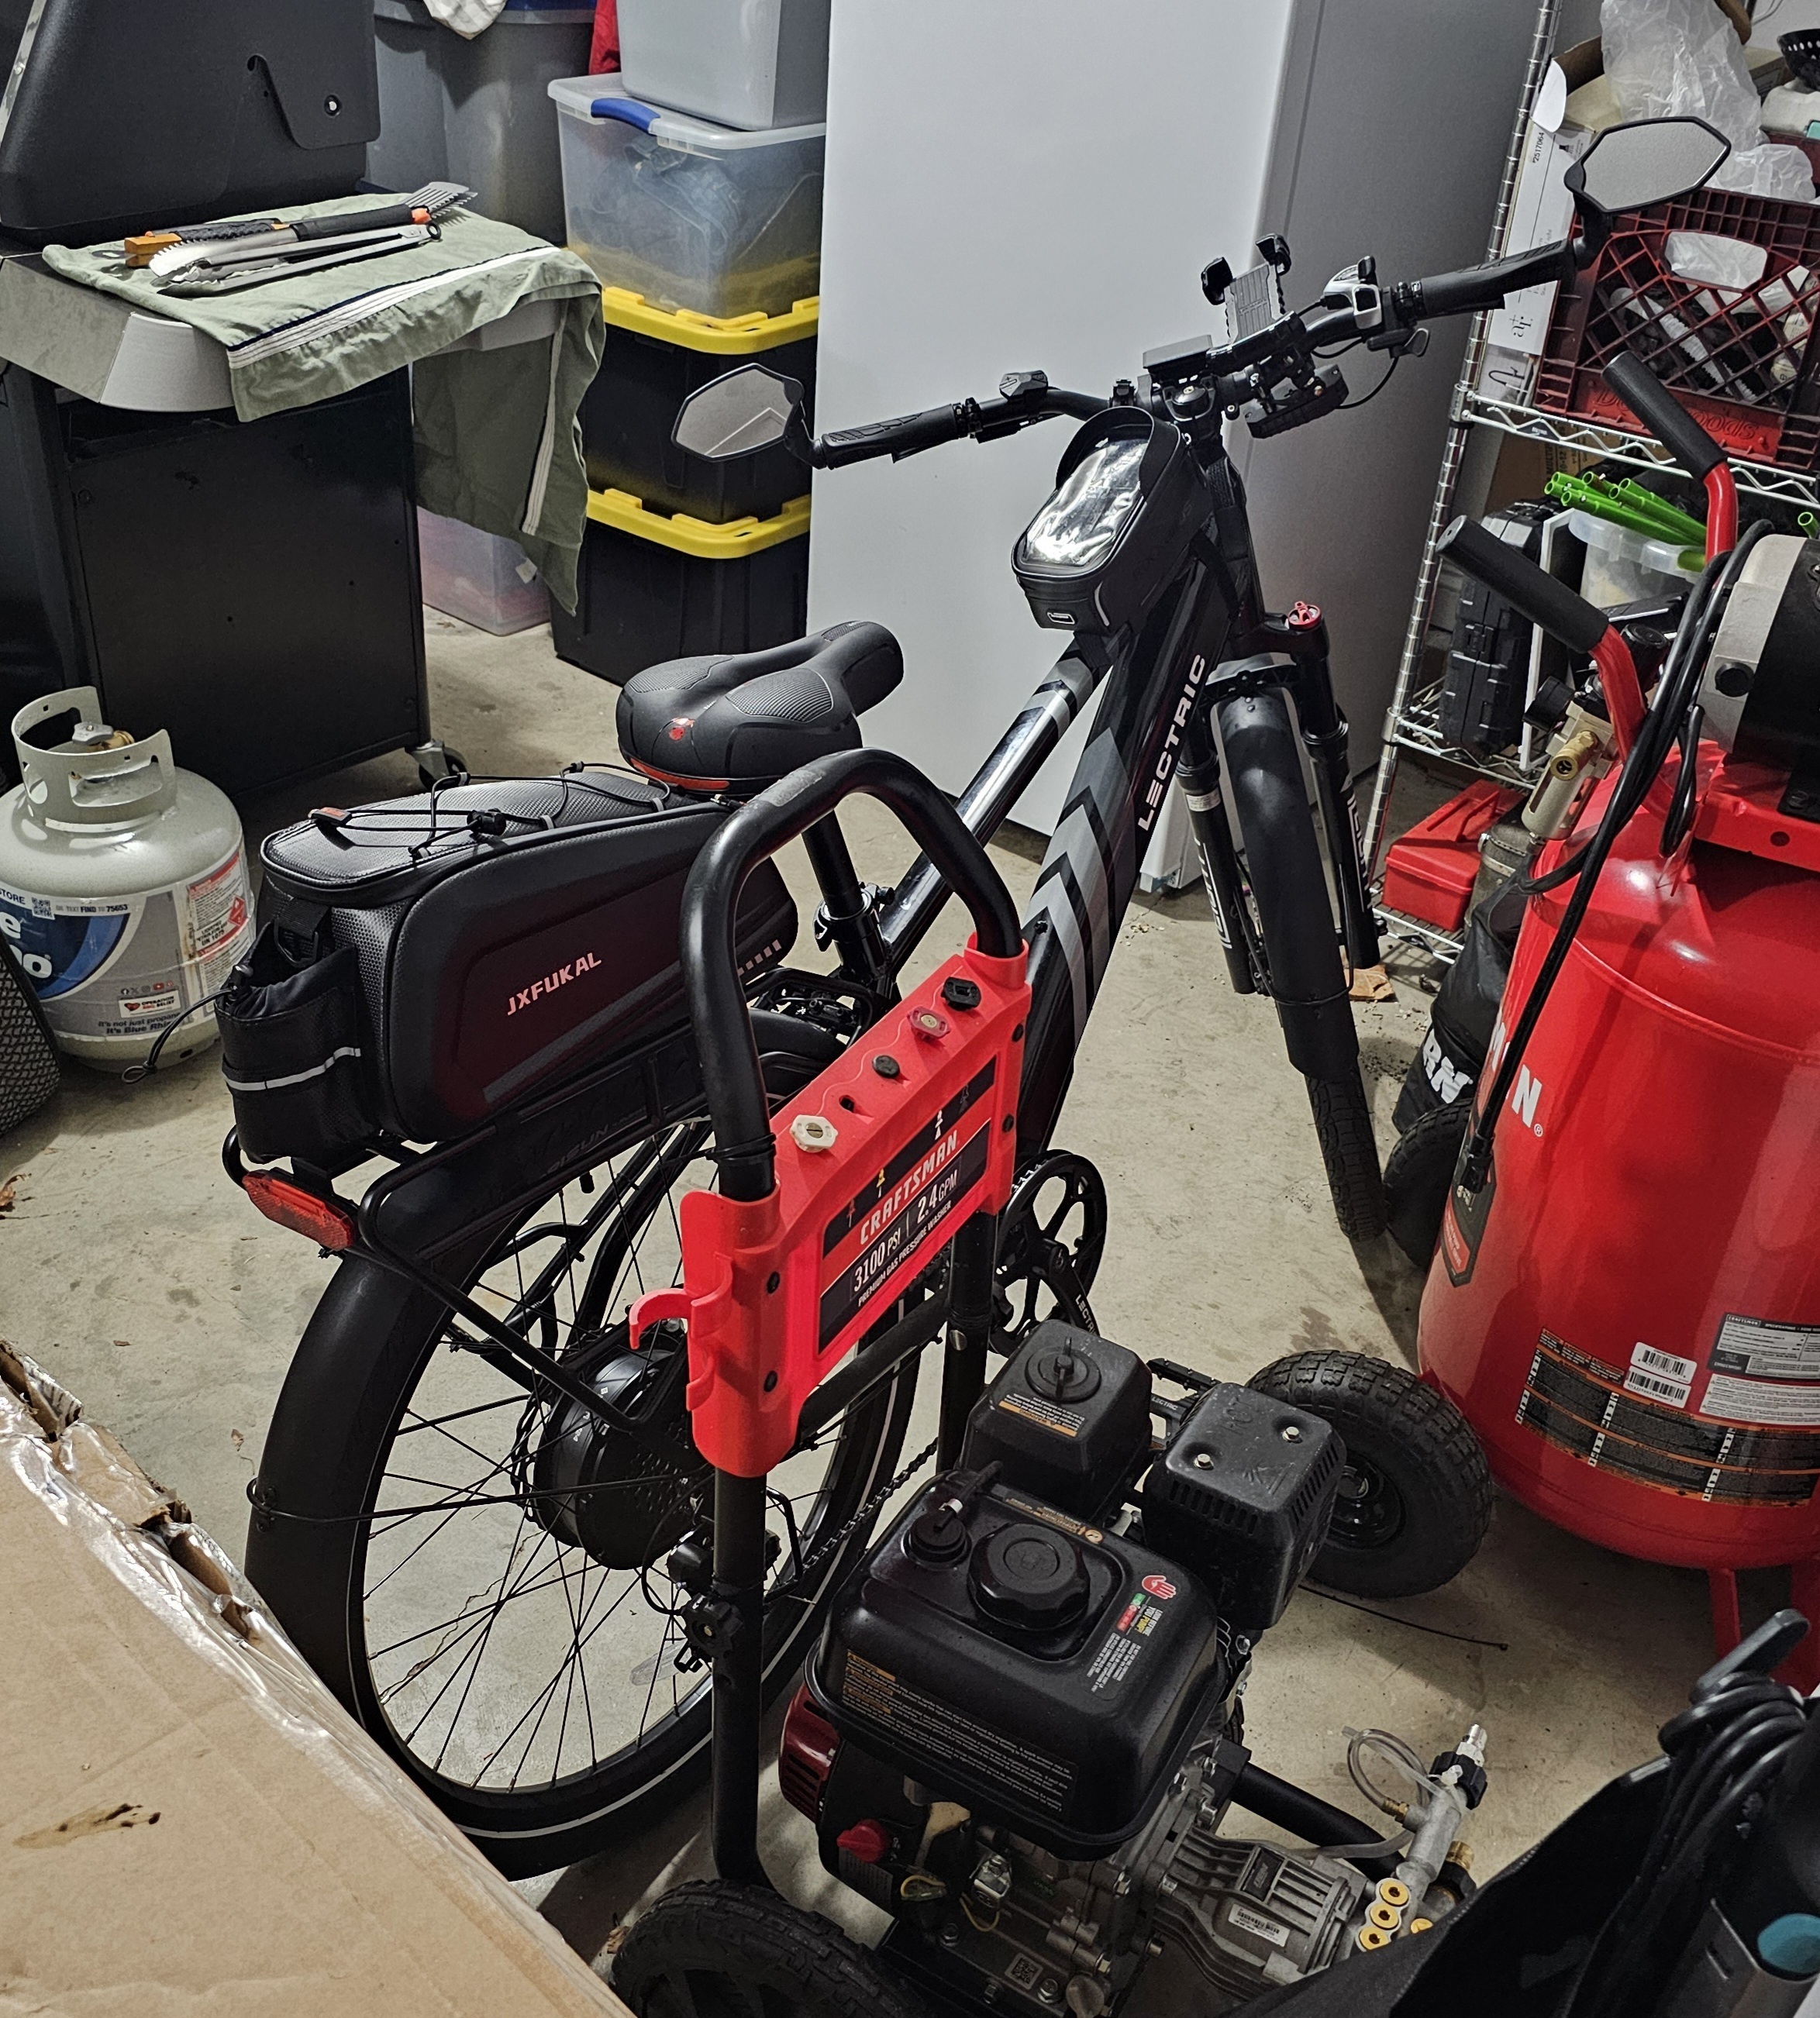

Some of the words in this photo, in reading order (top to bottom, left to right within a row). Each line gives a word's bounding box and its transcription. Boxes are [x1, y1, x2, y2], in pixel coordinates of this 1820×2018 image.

[1138, 654, 1206, 832] LECTRIC
[80, 905, 97, 914] FIND
[508, 952, 602, 1016] JXFUKAL
[124, 1024, 147, 1034] Blue
[860, 1130, 958, 1245] CRAFTSMAN
[853, 1241, 885, 1293] 3100
[887, 1227, 901, 1257] PSI
[916, 1183, 938, 1224] 2.4
[938, 1169, 958, 1202] GPM
[858, 1270, 887, 1307] PREMIUM
[886, 1257, 899, 1277] GAS
[898, 1224, 928, 1262] PRESSURE
[928, 1200, 952, 1231] WASHER
[1151, 1396, 1178, 1411] LECTRIC
